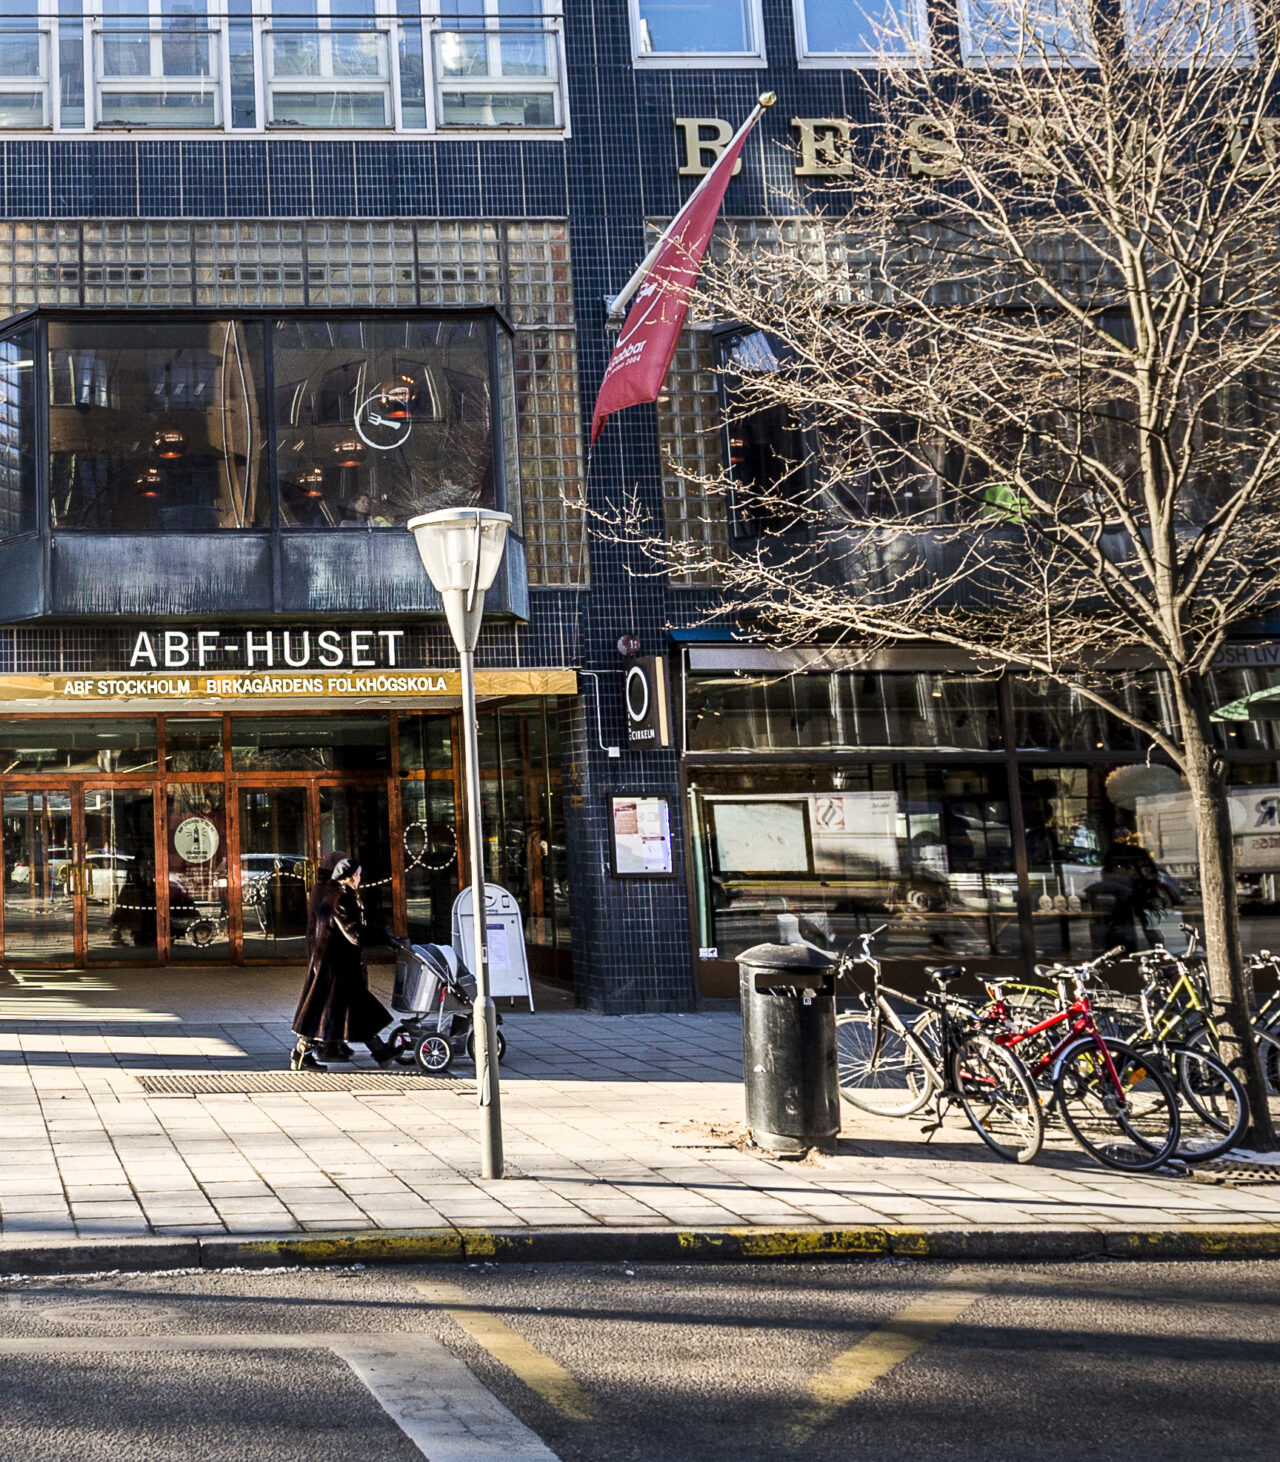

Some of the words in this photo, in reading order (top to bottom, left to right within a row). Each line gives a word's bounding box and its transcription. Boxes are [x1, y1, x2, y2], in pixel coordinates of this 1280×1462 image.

[129, 630, 405, 667] ABF-HUSET
[64, 680, 94, 695] ABF
[97, 679, 190, 695] STOCKHOLM
[206, 676, 324, 693] BIRKAGÅRDENS
[328, 675, 448, 692] FOLKHÖGSKOLA
[631, 728, 655, 741] CIRKELN
